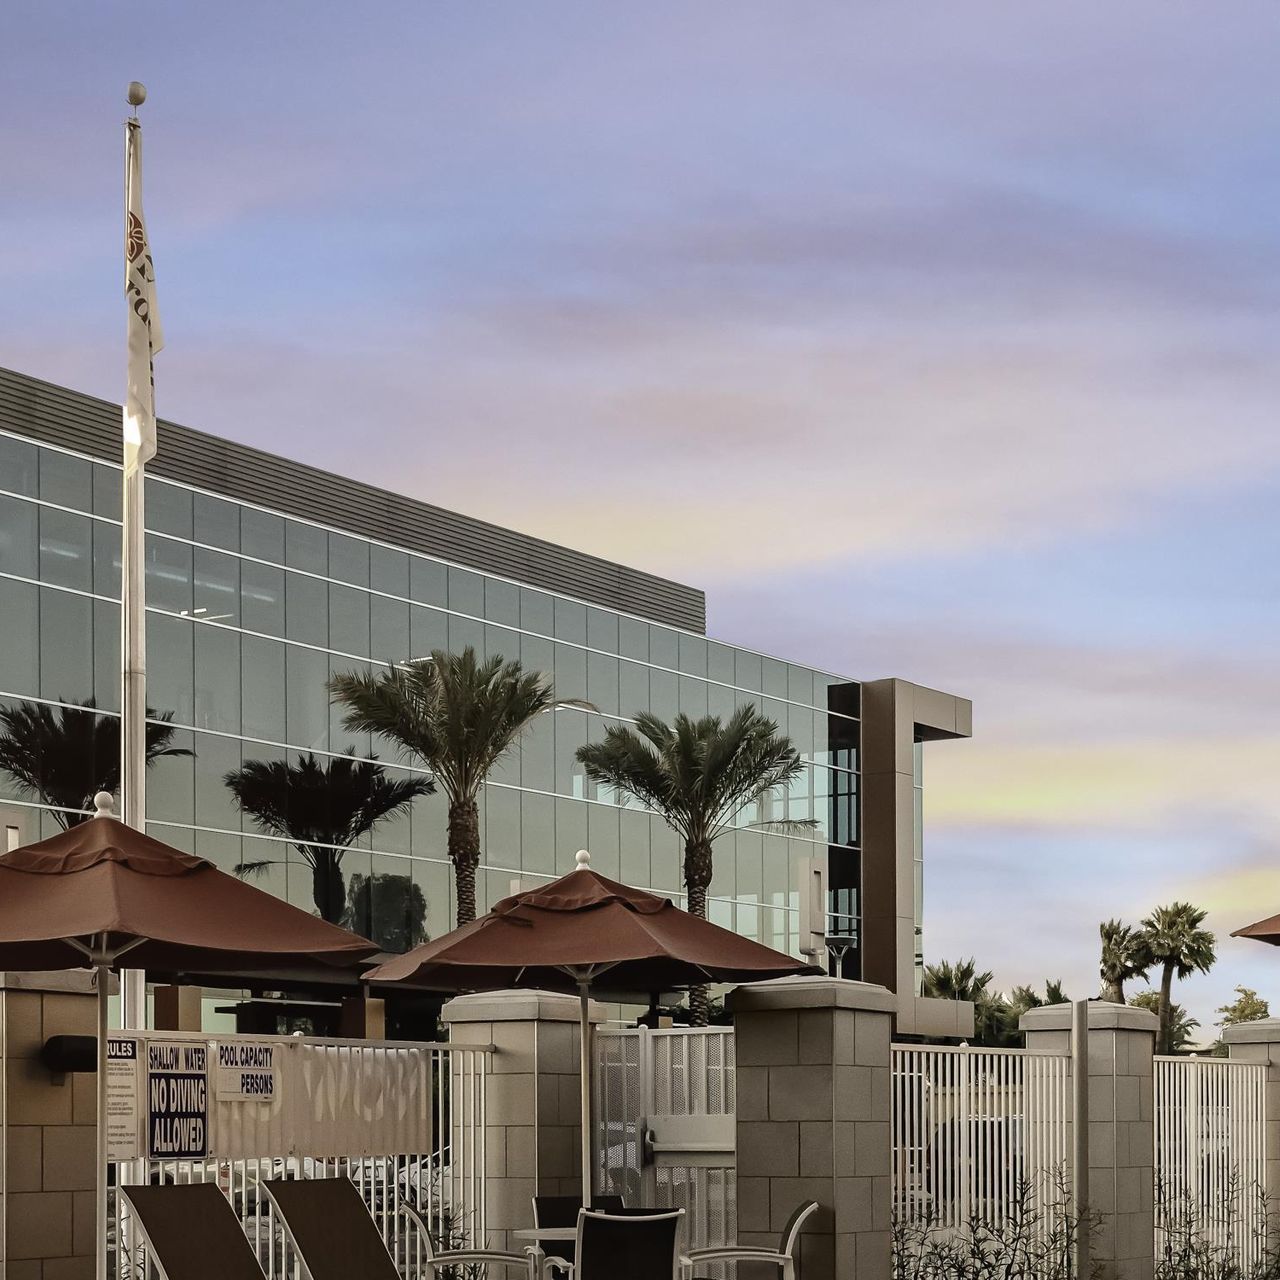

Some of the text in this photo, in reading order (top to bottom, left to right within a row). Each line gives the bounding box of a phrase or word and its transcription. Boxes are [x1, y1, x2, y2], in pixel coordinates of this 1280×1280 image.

[149, 1046, 206, 1071] SHALLOW WATER
[220, 1046, 273, 1067] POOL CAPACITY
[151, 1078, 167, 1113] NO
[170, 1078, 206, 1113] DIVING
[241, 1073, 273, 1095] PERSONS
[153, 1117, 204, 1152] ALLOWED
